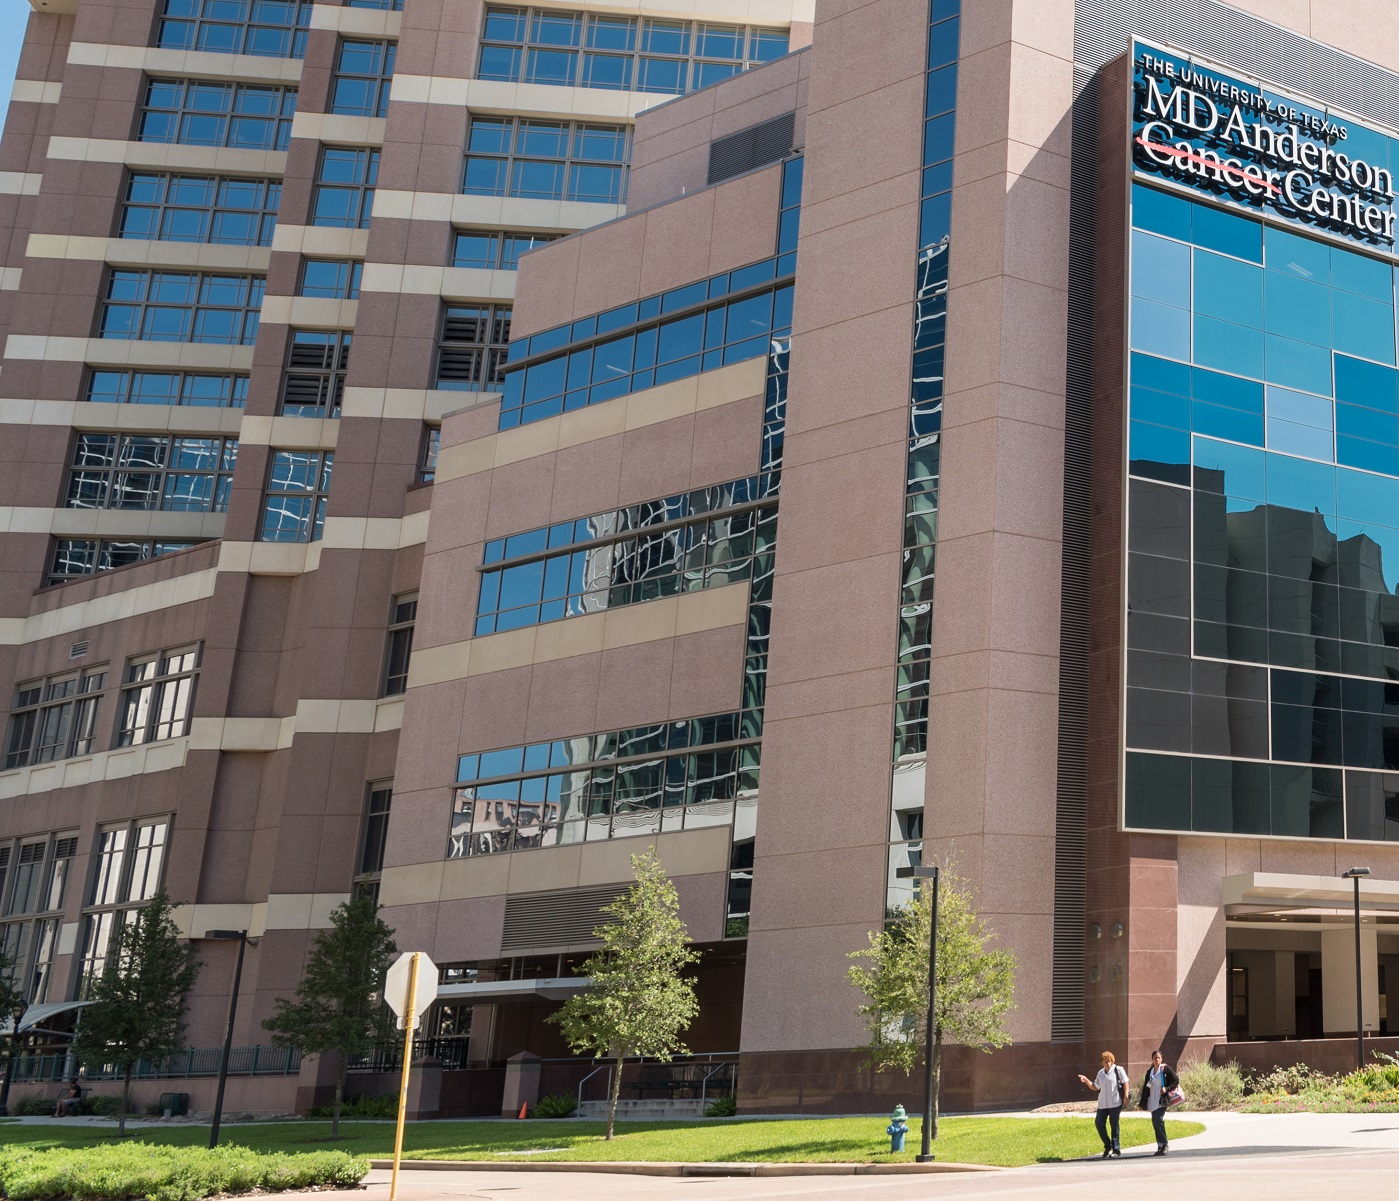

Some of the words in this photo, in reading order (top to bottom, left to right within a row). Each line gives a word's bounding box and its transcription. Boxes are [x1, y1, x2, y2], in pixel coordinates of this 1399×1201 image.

[1142, 54, 1174, 76] THE
[1182, 65, 1273, 111] UNIVERSITY
[1277, 104, 1297, 119] OF
[1302, 112, 1347, 139] TEXAS
[1141, 121, 1281, 198] Cancer
[1285, 170, 1396, 238] Center
